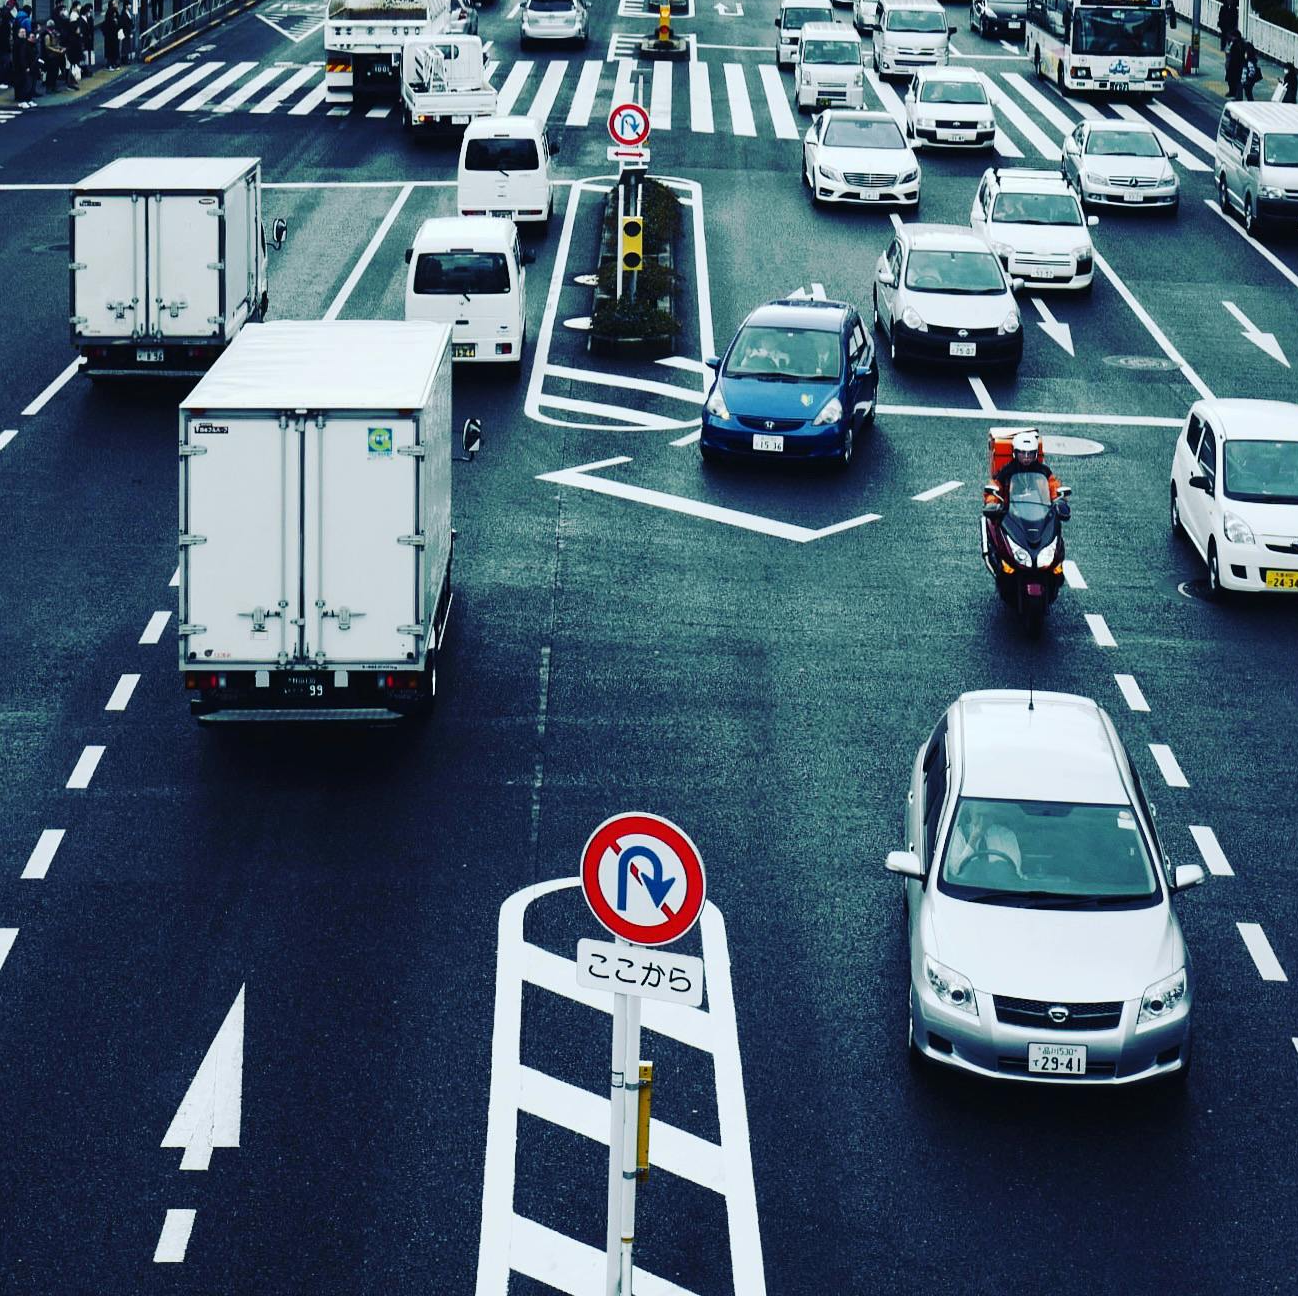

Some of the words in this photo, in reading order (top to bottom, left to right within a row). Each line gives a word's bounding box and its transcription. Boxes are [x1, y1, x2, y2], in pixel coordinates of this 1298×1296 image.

[588, 953, 692, 993] ここから
[1041, 1056, 1081, 1072] 29-41
